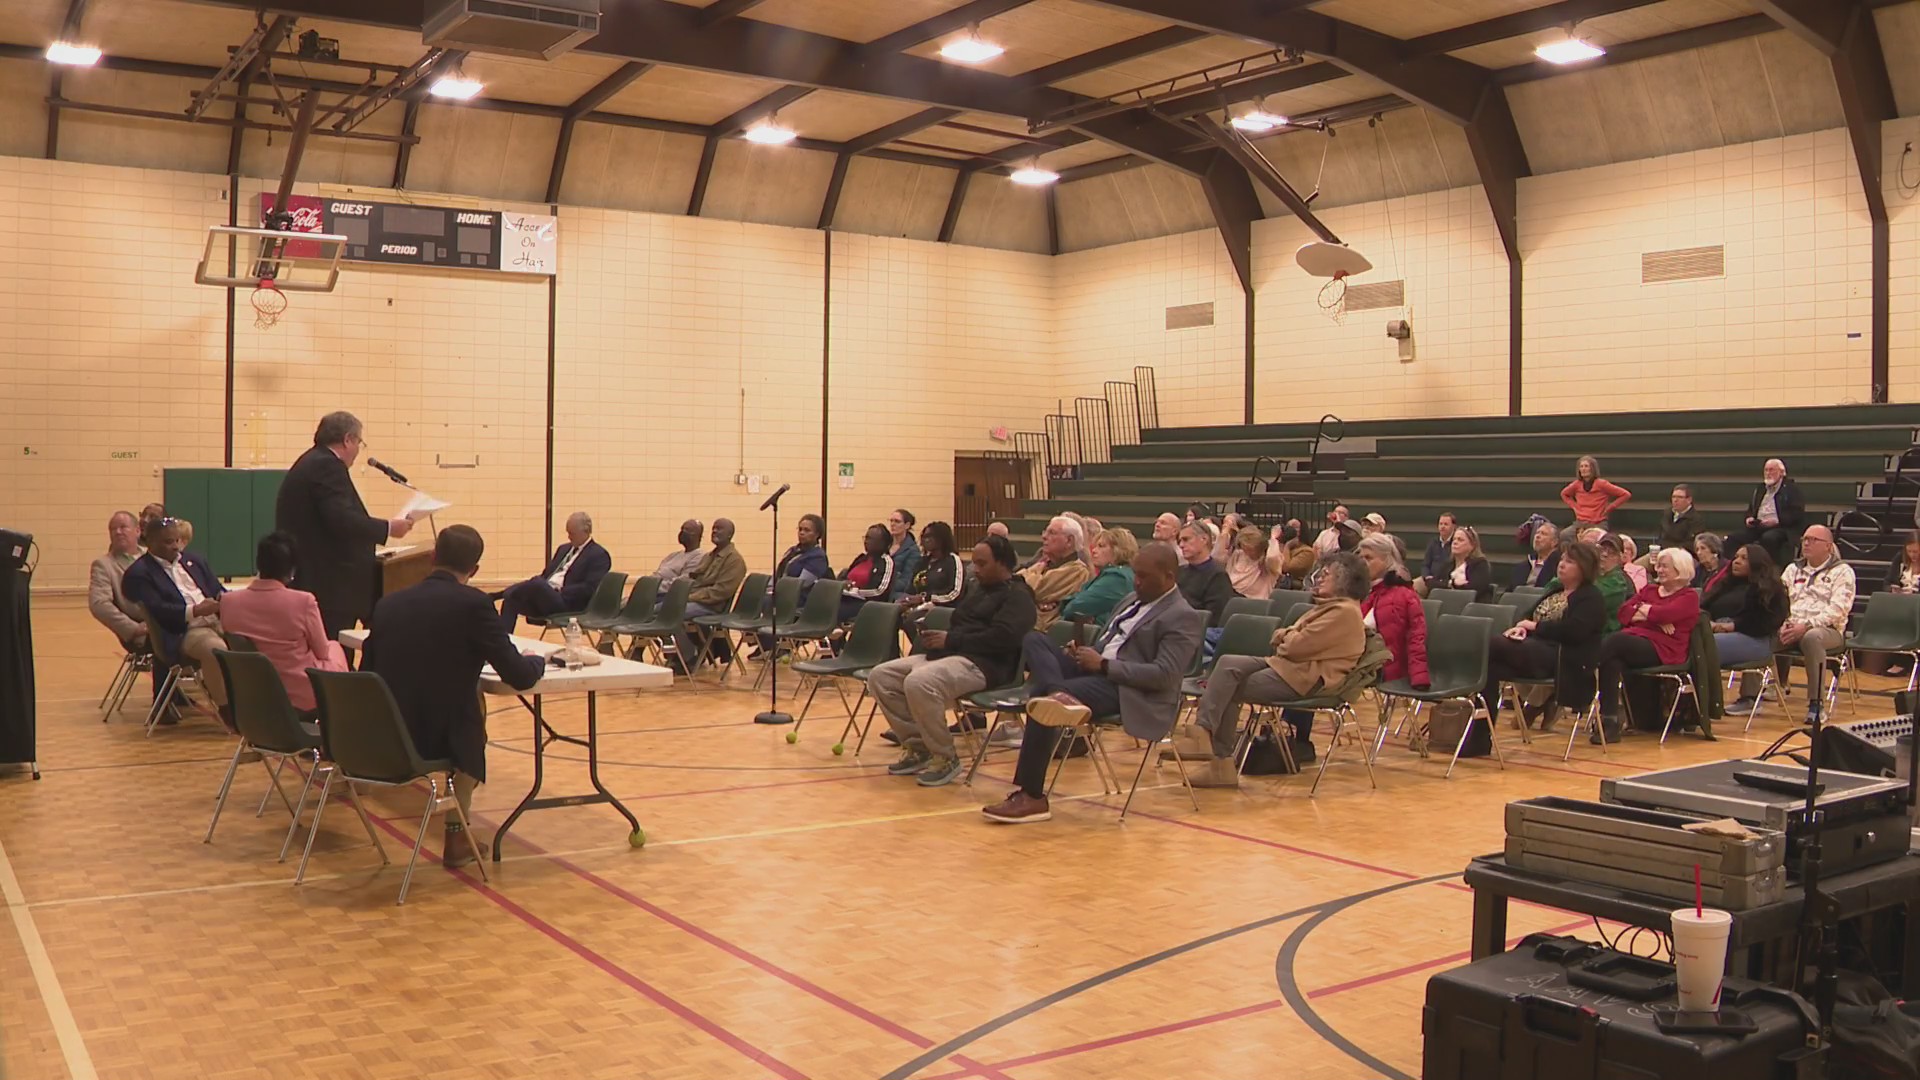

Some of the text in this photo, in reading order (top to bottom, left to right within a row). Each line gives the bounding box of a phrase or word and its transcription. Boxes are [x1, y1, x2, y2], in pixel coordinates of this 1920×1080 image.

[330, 202, 373, 216] GUEST
[456, 213, 493, 225] HOME
[521, 236, 536, 248] On
[380, 244, 418, 255] PERIOD
[513, 251, 544, 268] Hair
[111, 451, 138, 459] GUEST
